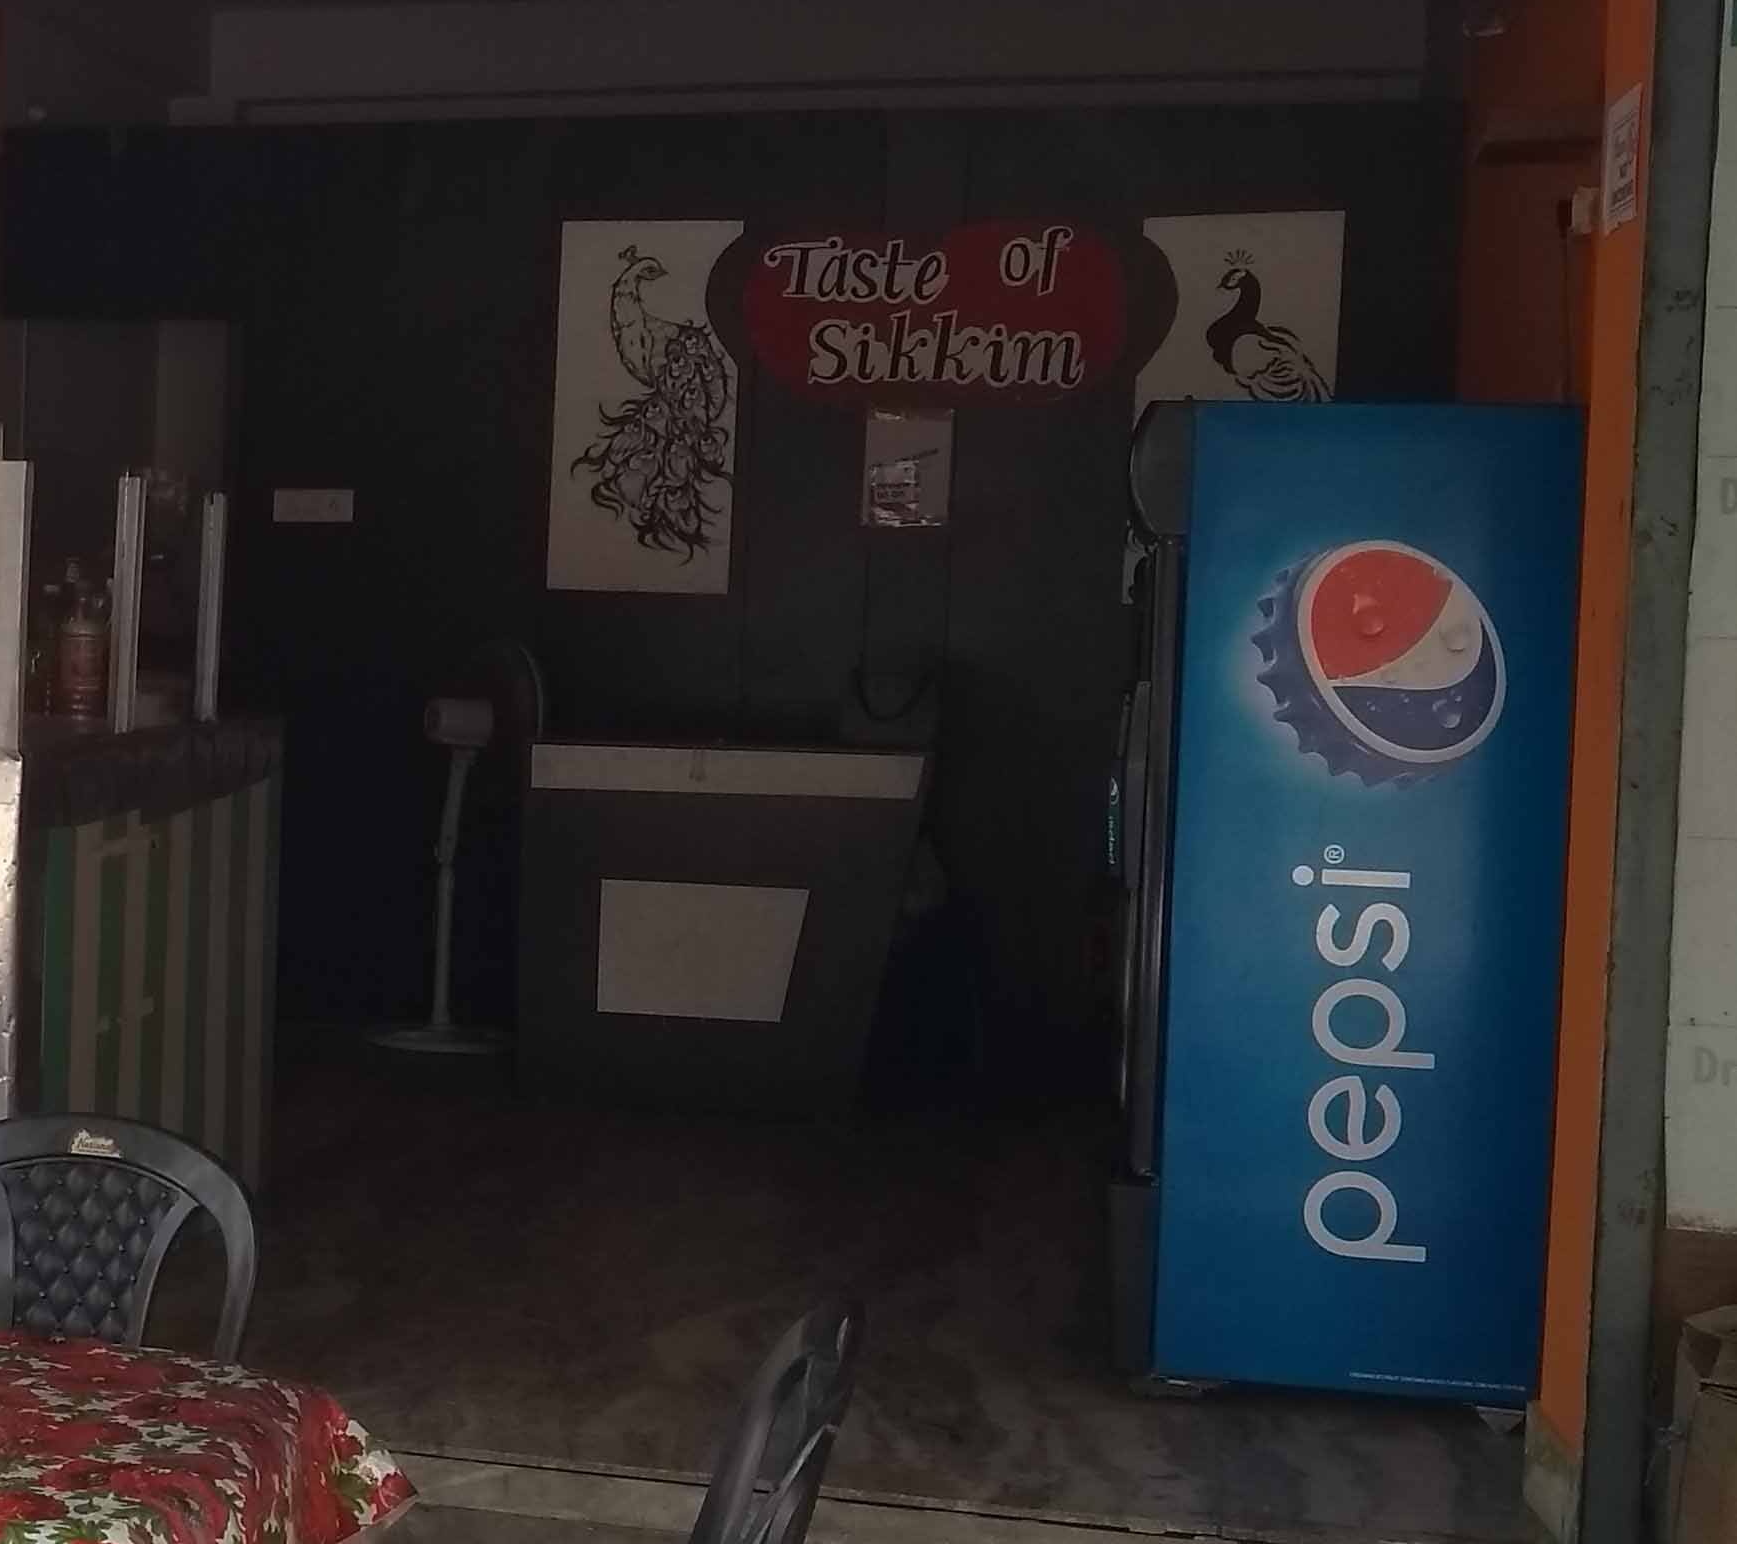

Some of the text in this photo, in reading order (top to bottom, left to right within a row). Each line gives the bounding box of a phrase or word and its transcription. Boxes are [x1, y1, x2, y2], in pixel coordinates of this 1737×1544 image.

[764, 226, 1074, 305] Taste of
[808, 309, 1086, 389] Sikkim
[1291, 864, 1436, 1263] pepsi
